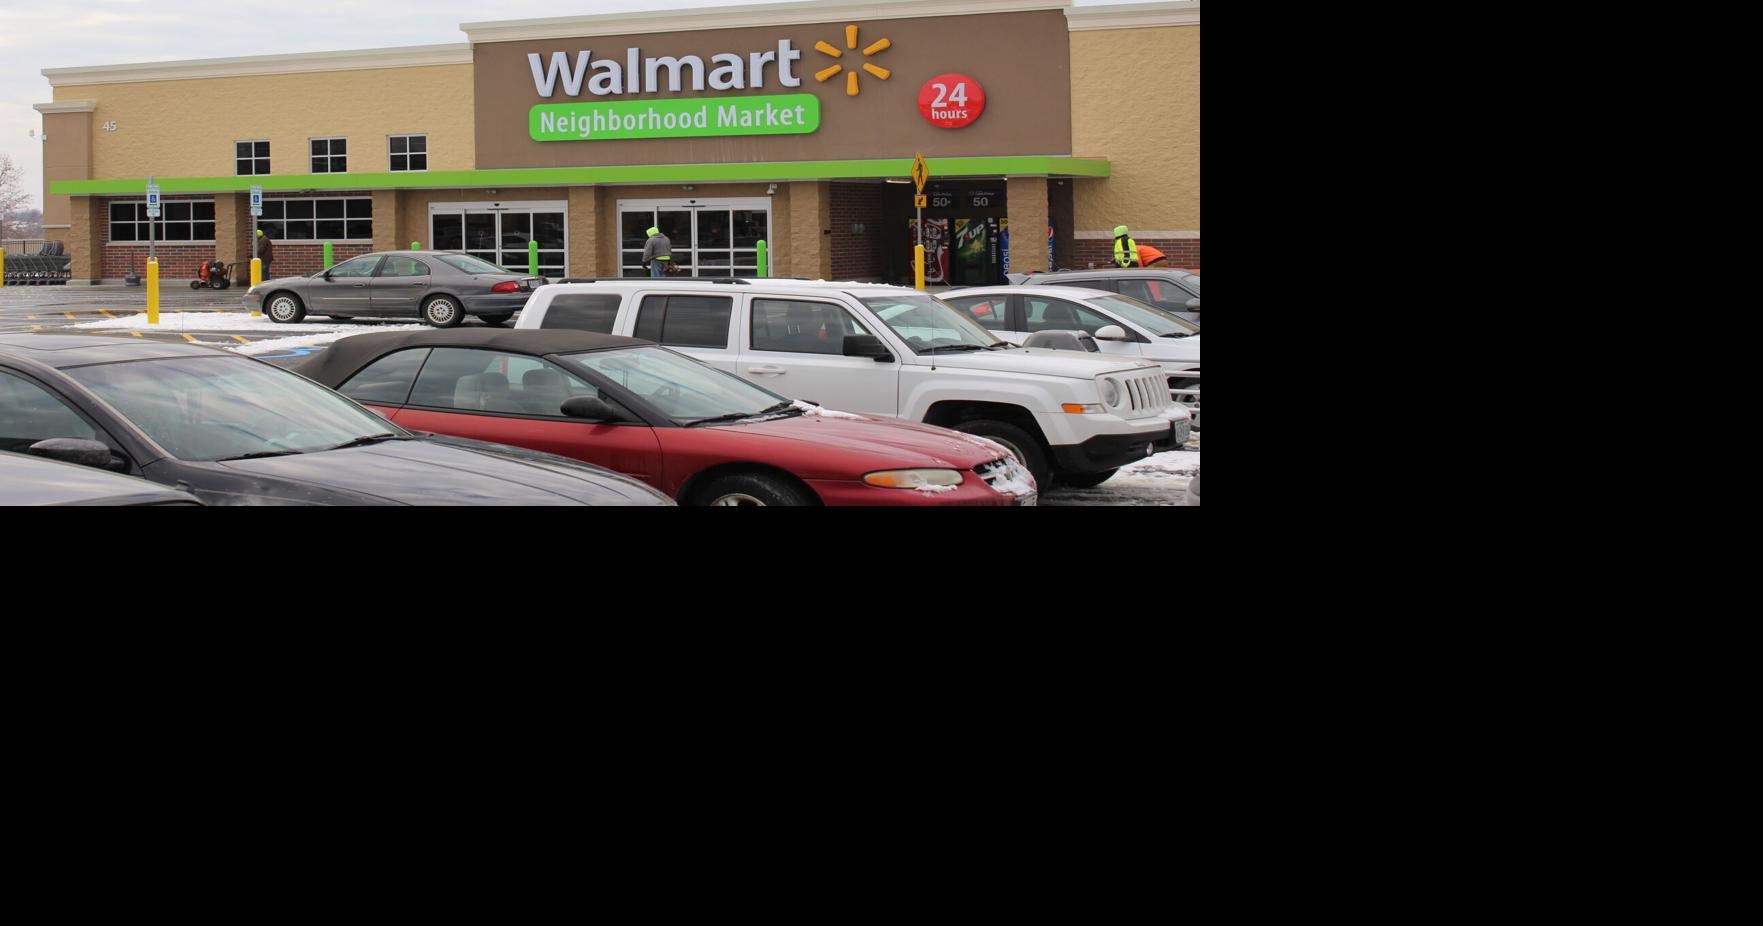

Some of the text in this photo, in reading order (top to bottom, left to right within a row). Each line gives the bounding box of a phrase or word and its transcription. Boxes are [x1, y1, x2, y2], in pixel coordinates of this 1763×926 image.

[528, 39, 801, 98] Walmart
[931, 82, 968, 107] 24
[540, 102, 805, 137] Neighborhood Market
[932, 108, 968, 119] hours
[102, 120, 117, 132] 45
[973, 196, 989, 207] 50
